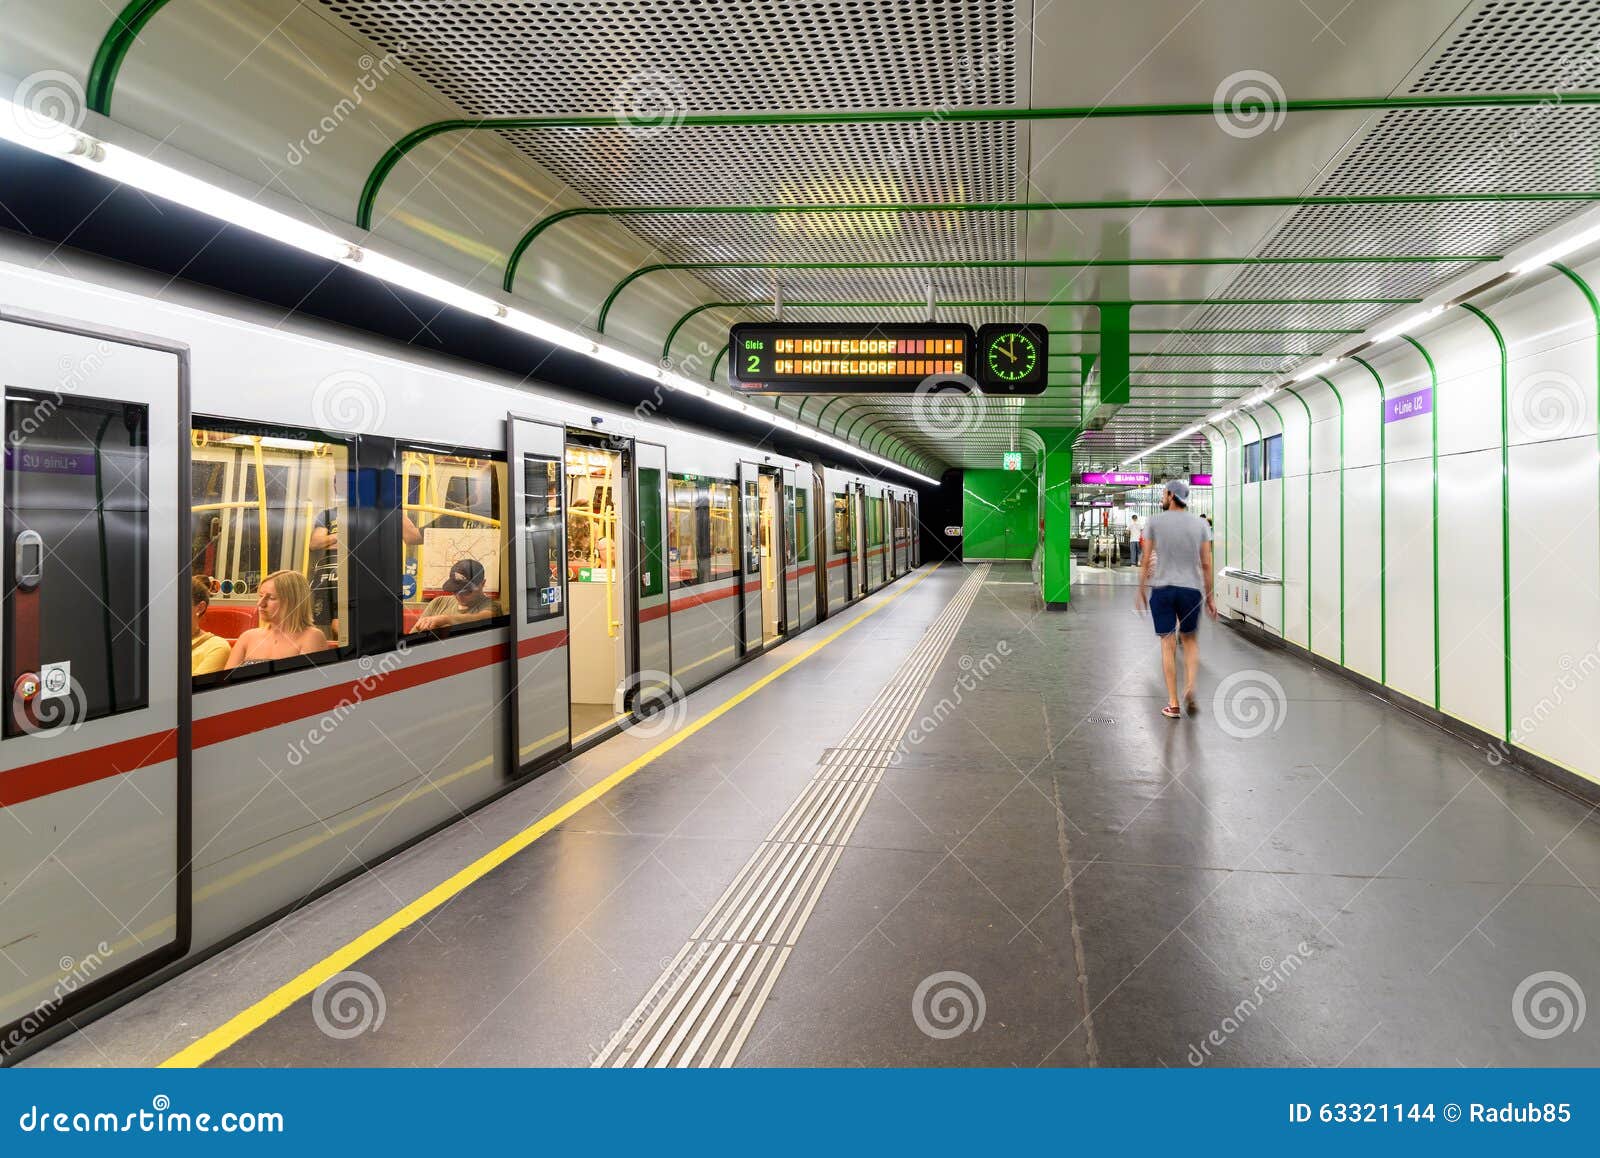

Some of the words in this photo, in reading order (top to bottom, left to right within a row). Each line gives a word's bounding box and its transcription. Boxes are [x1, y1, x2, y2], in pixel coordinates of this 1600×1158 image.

[745, 340, 764, 350] Gleis
[775, 339, 794, 353] U4
[747, 355, 761, 373] 2
[775, 360, 793, 374] U4
[954, 361, 963, 374] 9
[1399, 400, 1413, 415] Linie
[1414, 395, 1423, 410] U2
